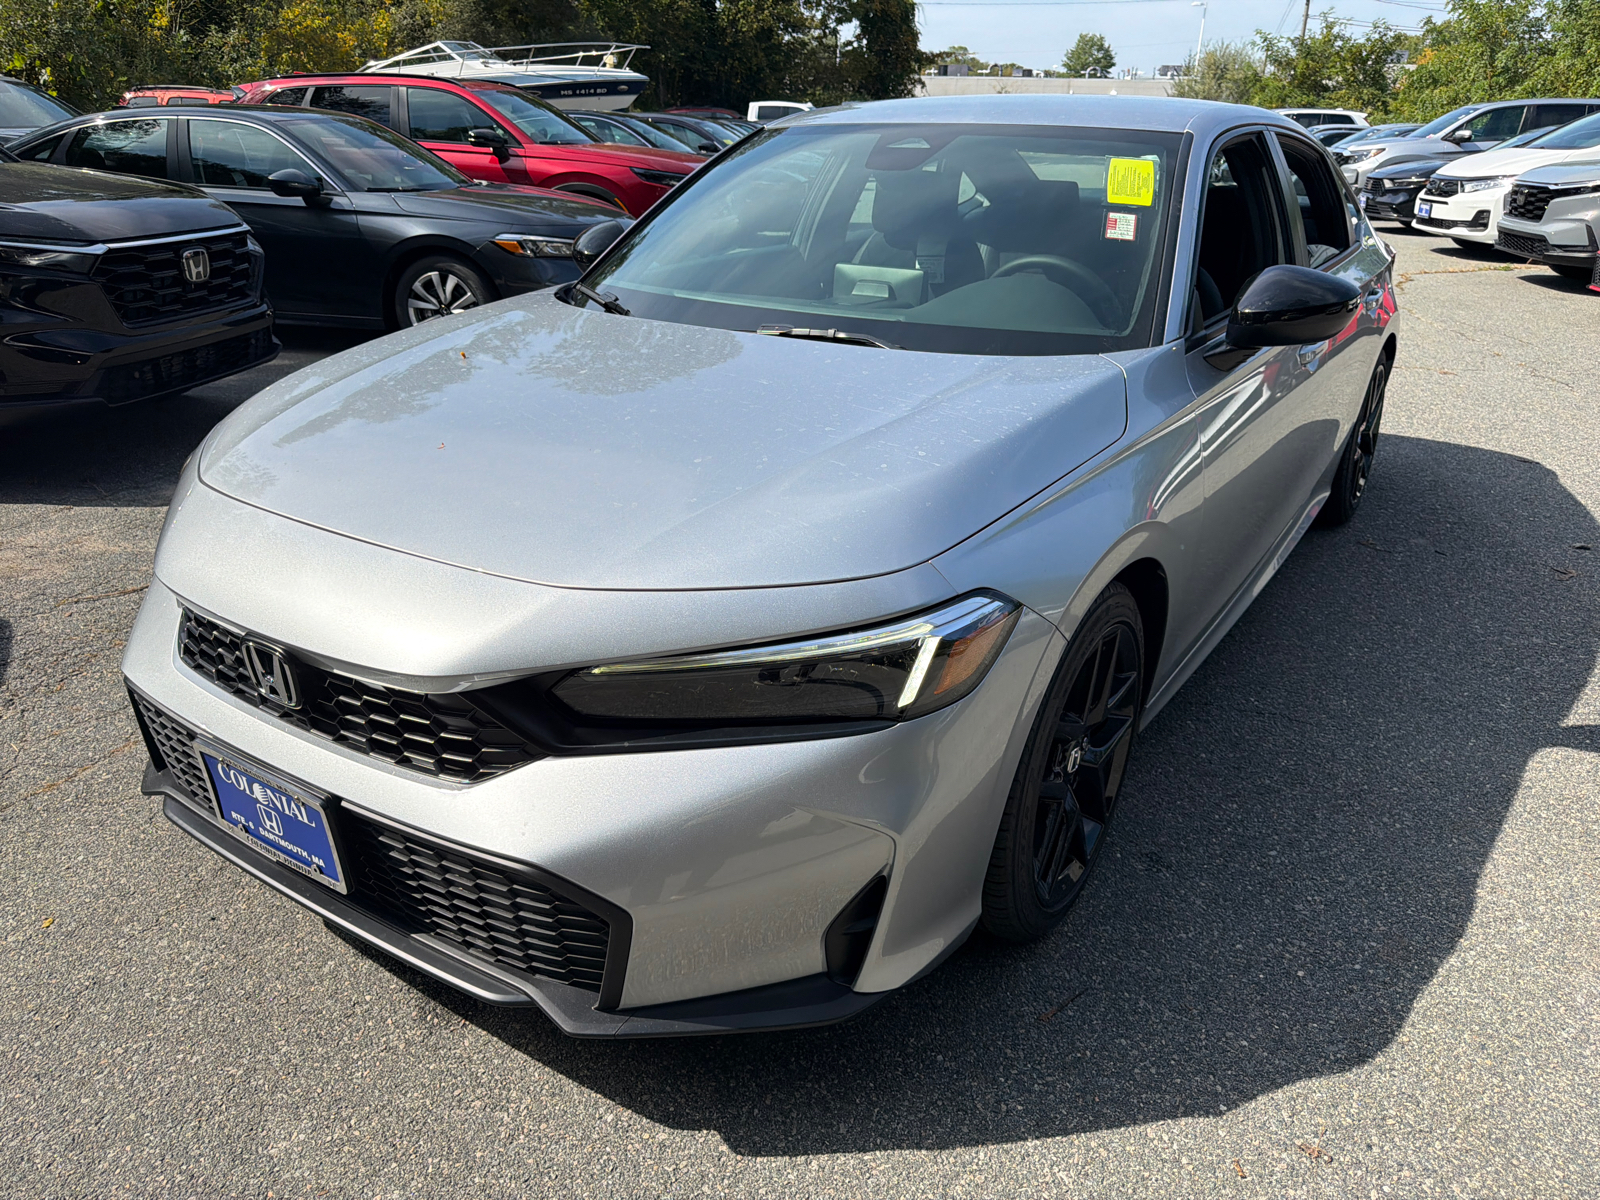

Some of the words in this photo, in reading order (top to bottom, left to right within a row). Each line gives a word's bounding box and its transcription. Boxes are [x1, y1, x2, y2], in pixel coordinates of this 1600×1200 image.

[217, 762, 316, 827] COLONIAL
[259, 826, 311, 861] DARTMOUTH,
[311, 855, 326, 868] MA
